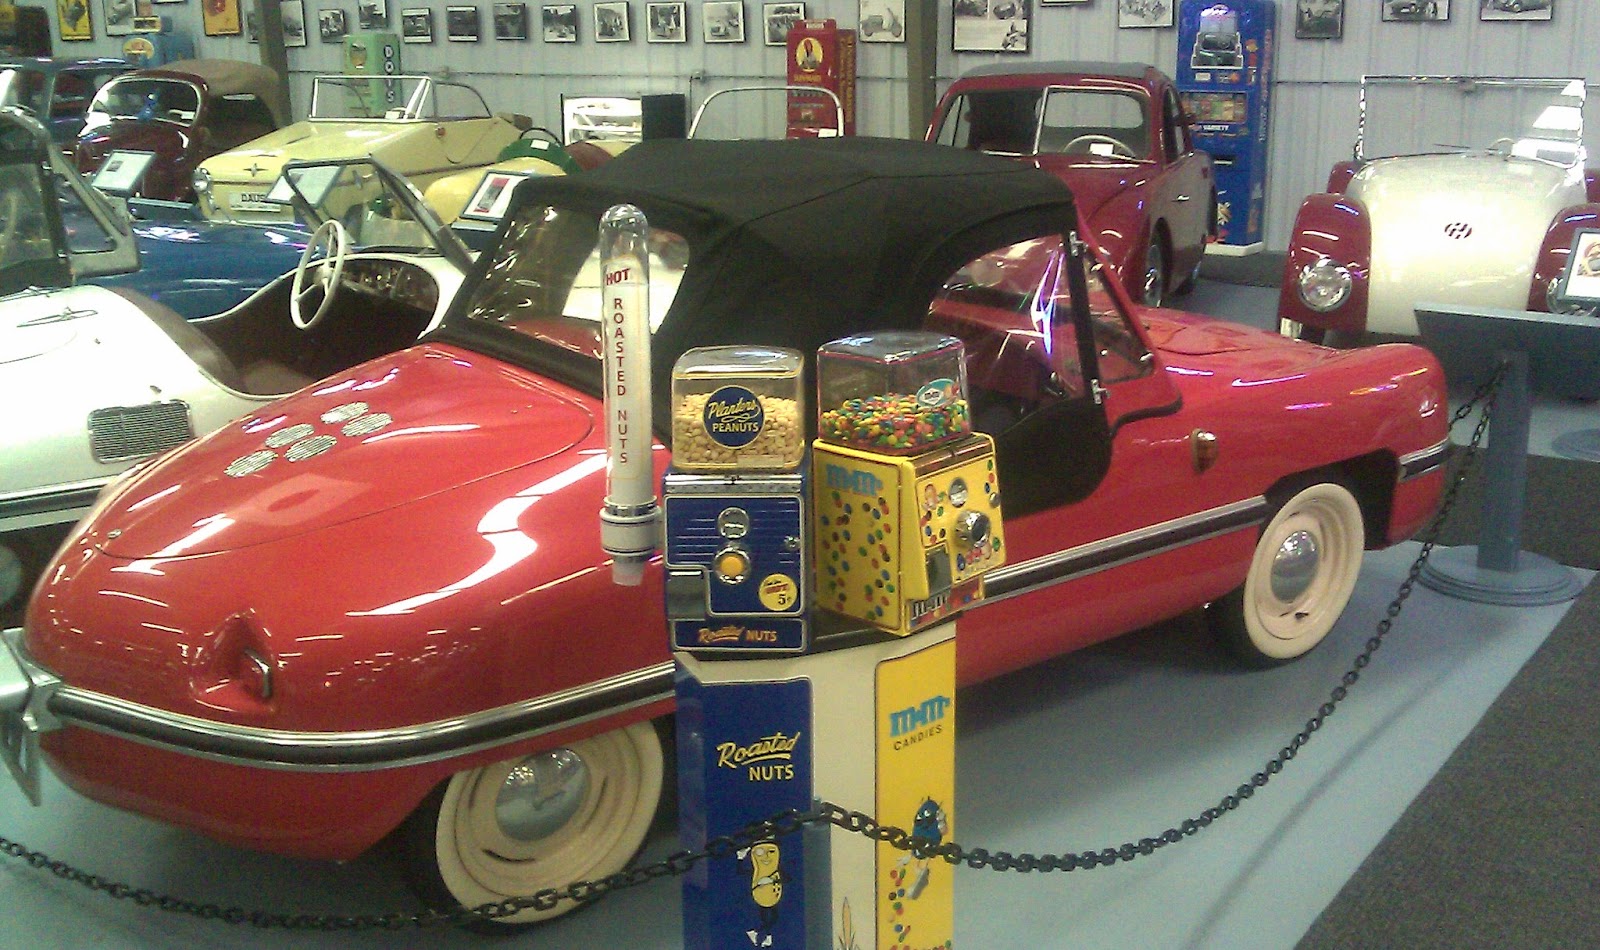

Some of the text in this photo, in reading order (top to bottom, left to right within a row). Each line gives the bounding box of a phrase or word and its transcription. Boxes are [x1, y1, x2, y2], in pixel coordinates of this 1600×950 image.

[606, 268, 631, 286] HOT
[613, 298, 628, 465] ROASTED NUTS
[708, 397, 761, 421] Planters
[712, 421, 760, 434] PEANUTS
[746, 629, 778, 642] NUTS
[893, 724, 944, 752] CANDIES
[716, 731, 801, 769] Roasted
[749, 764, 794, 782] NUTS
